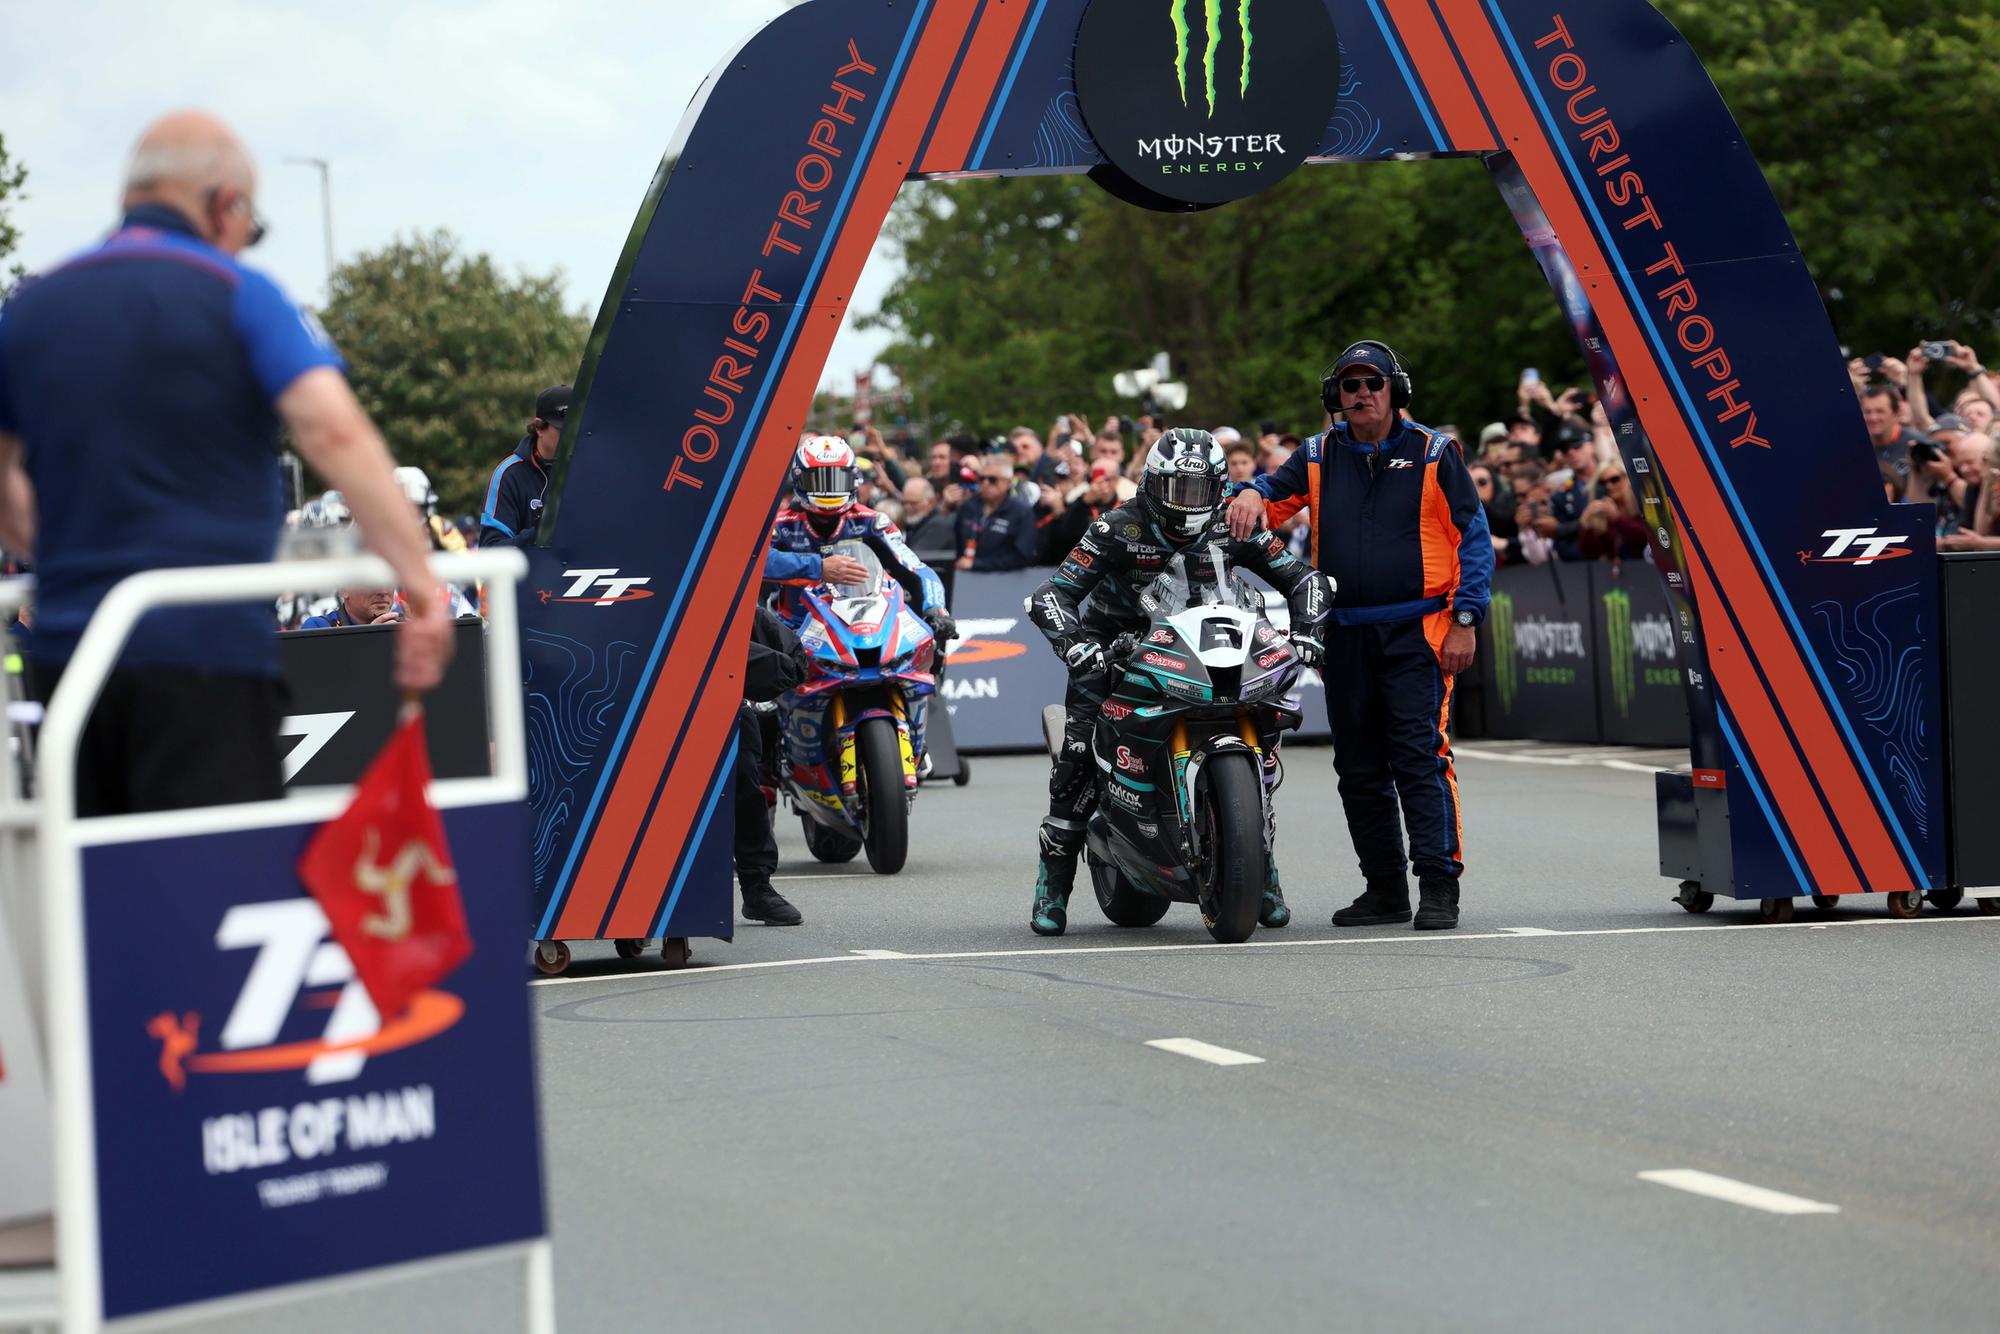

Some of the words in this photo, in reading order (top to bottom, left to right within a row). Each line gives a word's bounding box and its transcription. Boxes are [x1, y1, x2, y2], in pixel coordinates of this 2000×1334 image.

[1137, 132, 1286, 160] MONSTER
[1162, 161, 1264, 174] ENERGY
[1534, 14, 1663, 234] TOURIST
[1645, 241, 1772, 450] TROPHY
[663, 268, 782, 492] TOURIST
[762, 37, 878, 256] TROPHY
[1179, 457, 1204, 469] Arai
[1386, 458, 1413, 469] TT
[1821, 527, 1909, 565] TT
[562, 568, 651, 606] TT
[848, 599, 877, 624] 7
[1632, 613, 1676, 661] MONS
[202, 1107, 289, 1175] ISLE
[289, 1097, 346, 1160] OF
[345, 1083, 435, 1151] MAN
